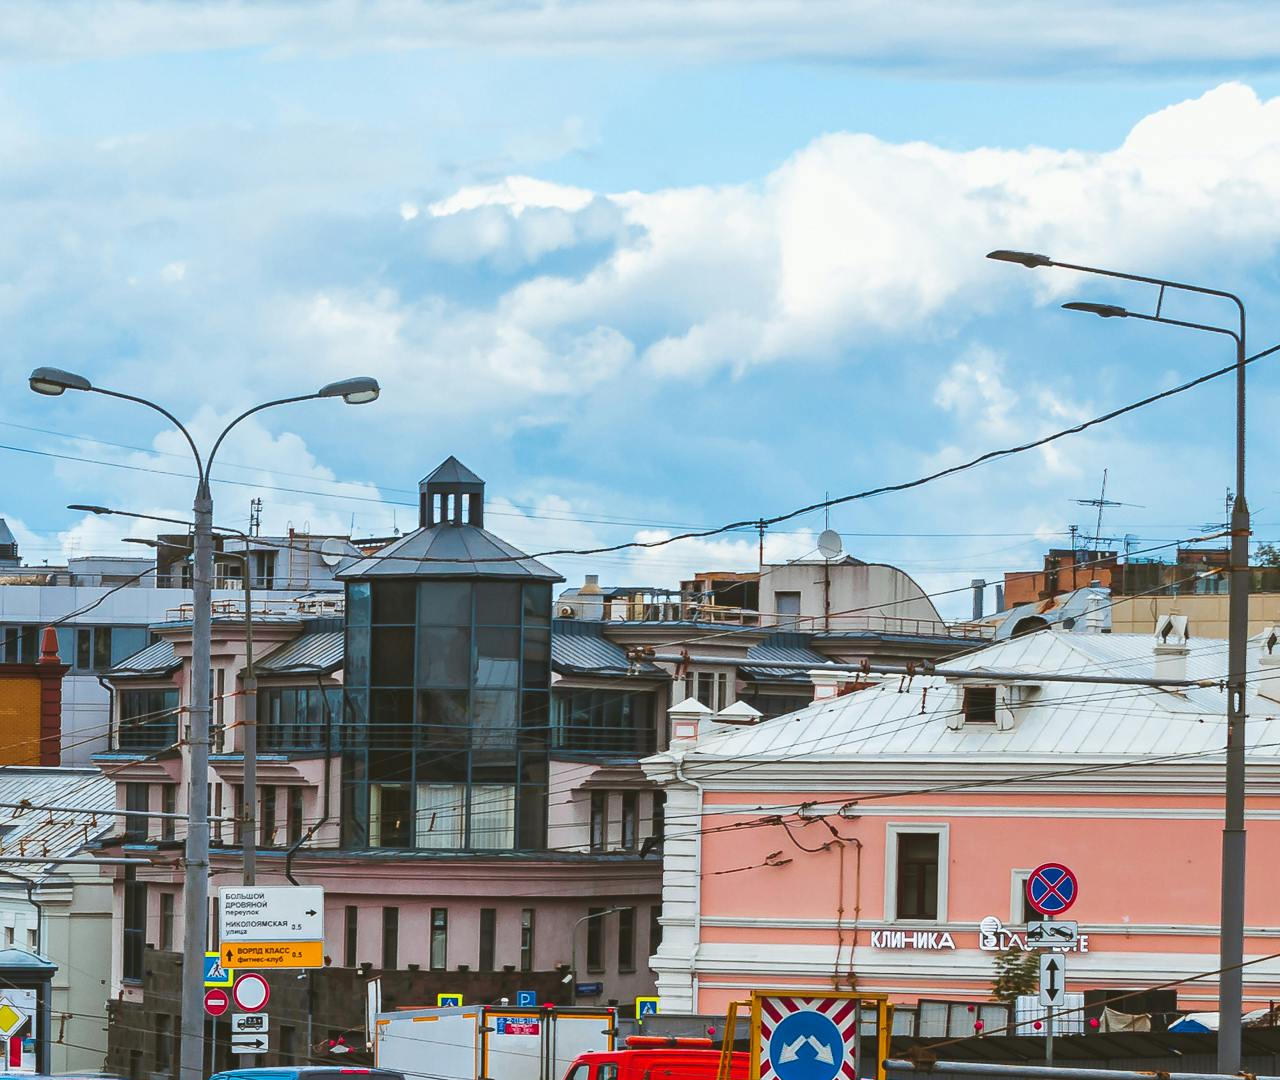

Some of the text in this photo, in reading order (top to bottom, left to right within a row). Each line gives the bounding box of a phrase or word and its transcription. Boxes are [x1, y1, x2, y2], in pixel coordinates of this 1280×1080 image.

[225, 892, 265, 900] БОЛЬШОЙ
[225, 900, 268, 909] ДРОВЯНОЙ
[225, 920, 288, 928] НИКОЛОЯМСКАЯ
[871, 930, 956, 950] КЛИНИКА
[237, 947, 263, 955] ВОРЛД
[237, 956, 284, 964] фитнес-клуб
